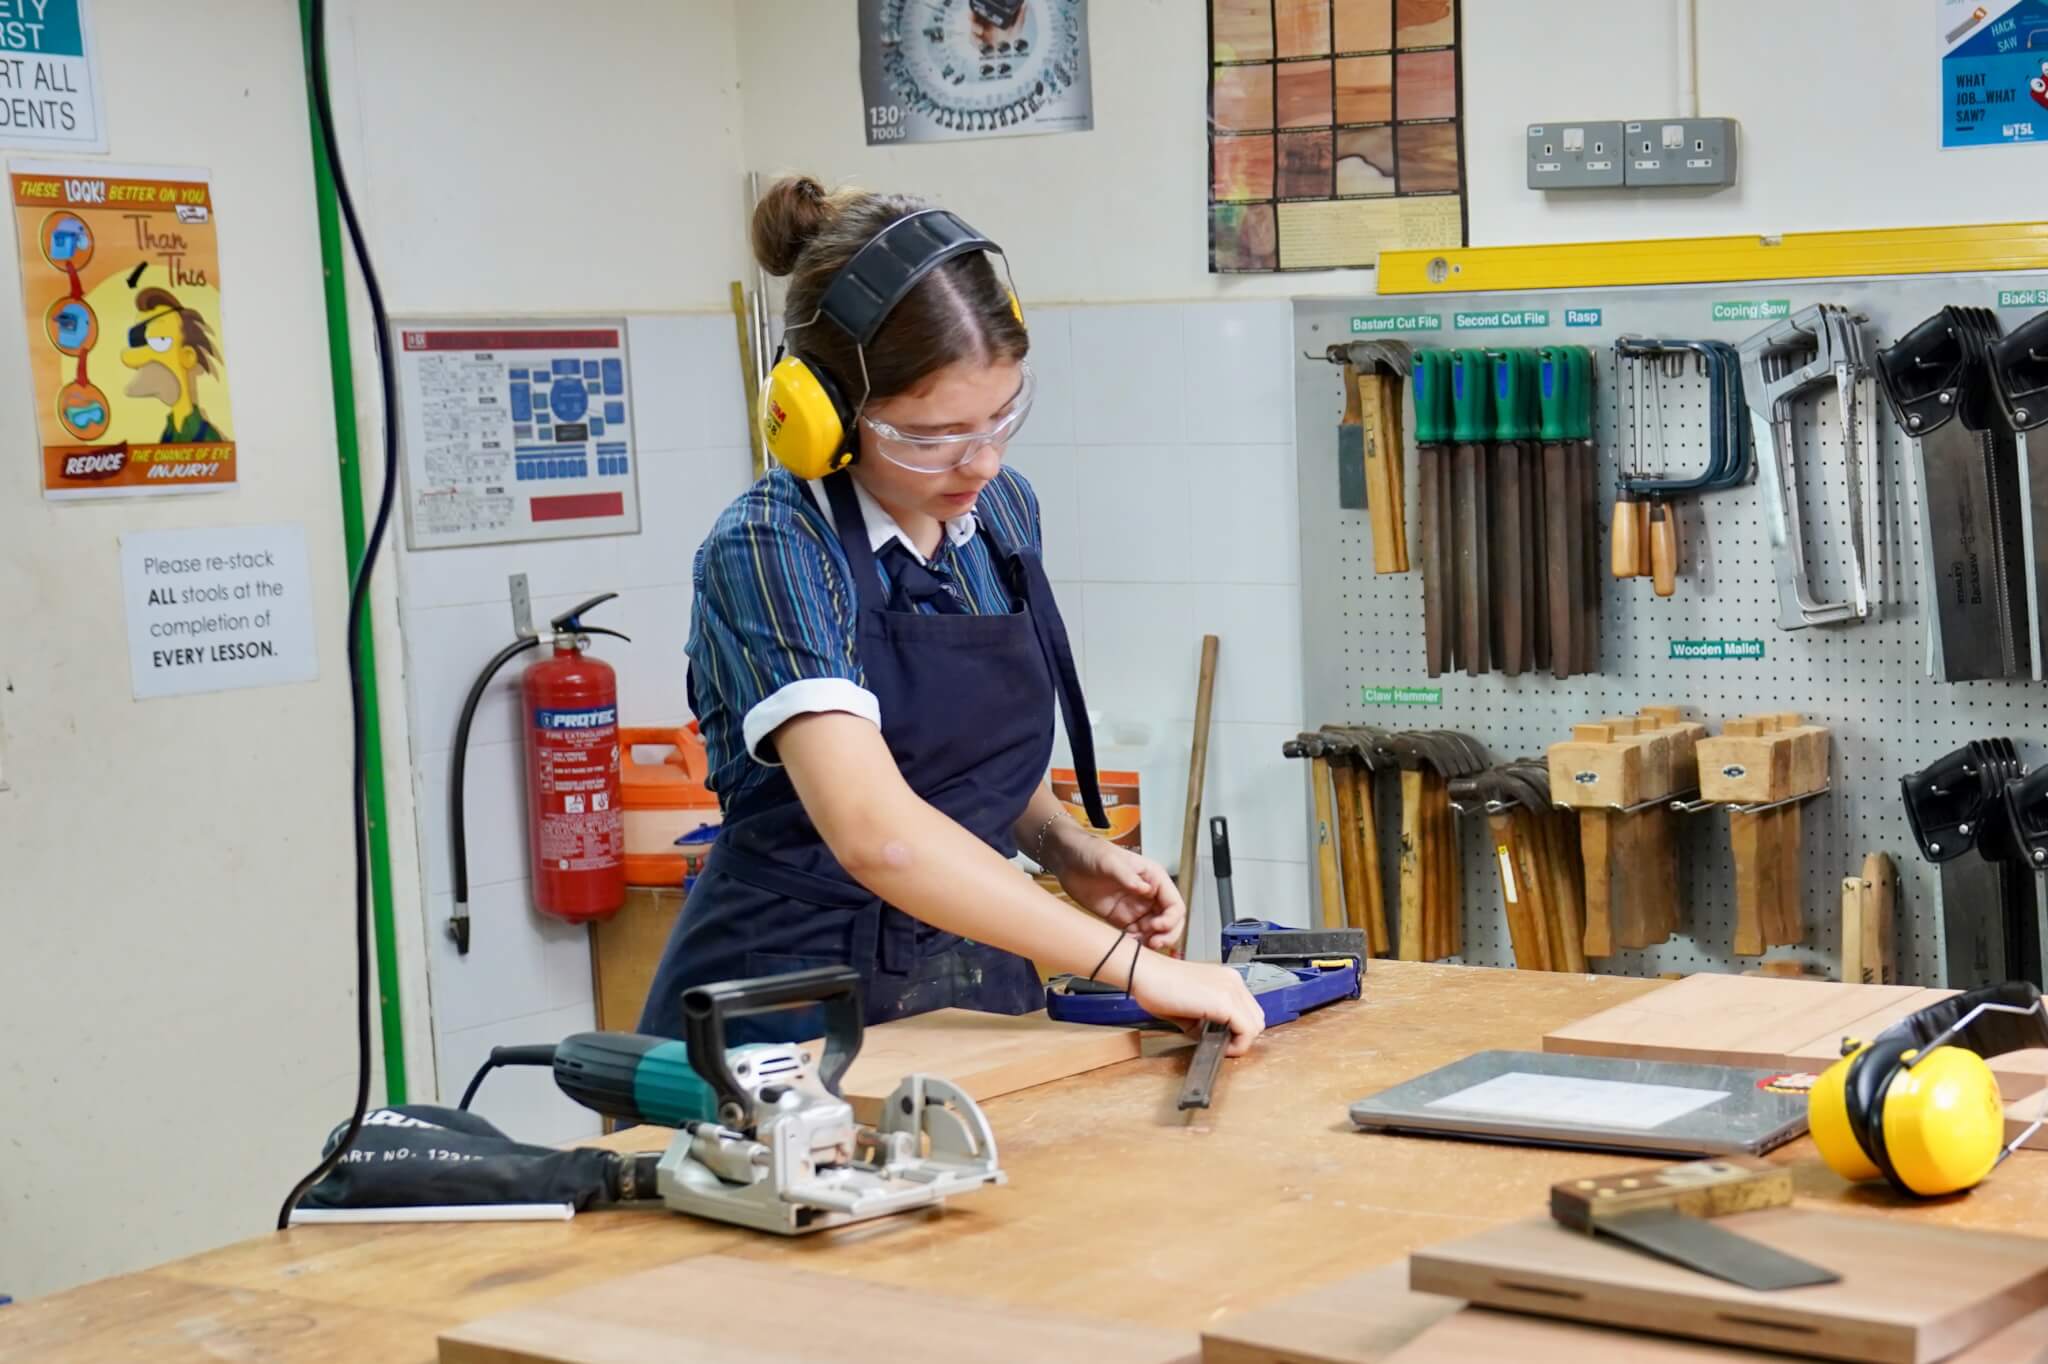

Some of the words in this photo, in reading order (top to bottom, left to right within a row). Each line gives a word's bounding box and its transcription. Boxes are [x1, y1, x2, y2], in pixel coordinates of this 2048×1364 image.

[1991, 17, 2016, 37] HACK
[1997, 35, 2018, 52] SAW
[34, 61, 78, 93] ALL
[1956, 73, 1986, 88] WHAT
[1956, 109, 1986, 123] SAW?
[871, 126, 906, 140] TOOLS
[20, 180, 60, 198] THESE
[64, 178, 106, 203] LOOK!
[109, 185, 156, 201] BETTER
[159, 186, 176, 203] ON
[181, 189, 206, 205] YOU
[123, 214, 187, 251] Than
[157, 251, 207, 288] This
[2002, 291, 2034, 305] Back
[2038, 290, 2048, 305] S
[1568, 310, 1598, 325] Rasp
[1714, 303, 1758, 319] Coping
[1760, 301, 1788, 316] Saw
[1353, 318, 1394, 331] Bastard
[1397, 317, 1416, 329] Cut
[1420, 316, 1439, 328] File
[1456, 313, 1498, 327] Second
[1501, 312, 1521, 326] Cut
[1524, 311, 1546, 325] File
[66, 453, 125, 475] REDUCE
[147, 462, 219, 478] INJURY!
[144, 556, 200, 575] Please
[206, 549, 275, 571] re-stack
[148, 587, 177, 606] ALL
[181, 584, 229, 604] stools
[233, 582, 251, 600] at
[256, 580, 283, 598] the
[150, 614, 249, 637] completion
[254, 609, 271, 628] of
[153, 646, 205, 668] EVERY
[211, 640, 278, 662] LESSON.
[1673, 643, 1722, 656] Wooden
[1724, 642, 1760, 655] Mallet
[1366, 689, 1392, 702] Claw
[1394, 690, 1440, 702] Hammer
[554, 709, 615, 728] PROTEC
[338, 1149, 376, 1164] ART
[384, 1147, 417, 1162] NO.
